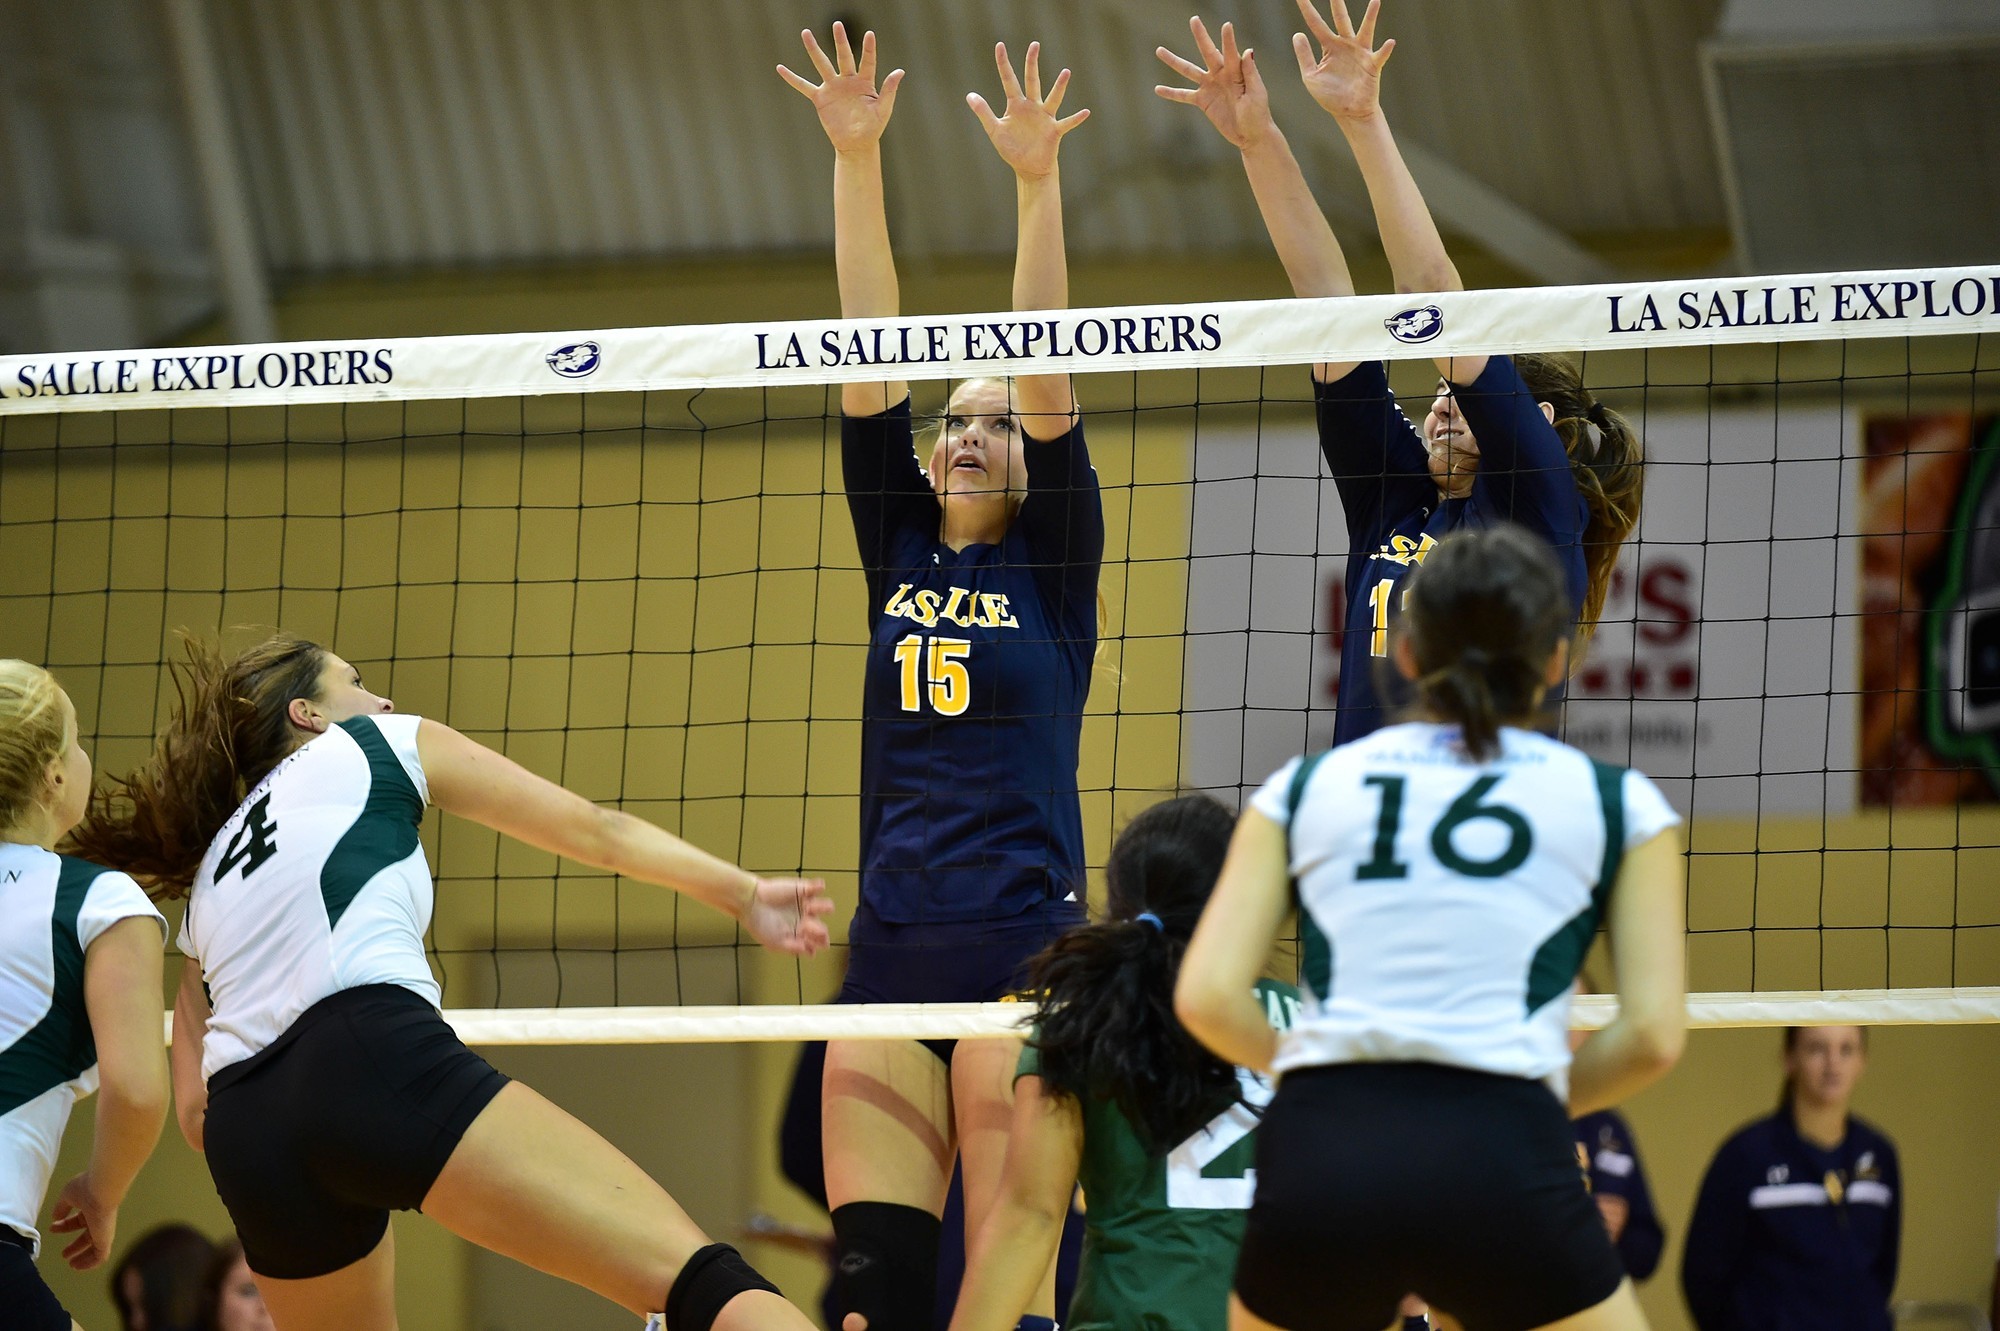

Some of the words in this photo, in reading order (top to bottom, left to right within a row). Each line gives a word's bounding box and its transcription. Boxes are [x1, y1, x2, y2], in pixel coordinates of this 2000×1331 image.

[754, 332, 810, 369] LA
[820, 325, 950, 367] SALLE
[962, 314, 1222, 361] EXPLORERS
[1607, 294, 1667, 333] LA
[1678, 285, 1819, 330] SALLE
[16, 359, 138, 398] SALLE
[151, 348, 393, 392] EXPLORERS
[894, 633, 971, 717] 15
[213, 790, 278, 887] 4
[1355, 774, 1533, 880] 16
